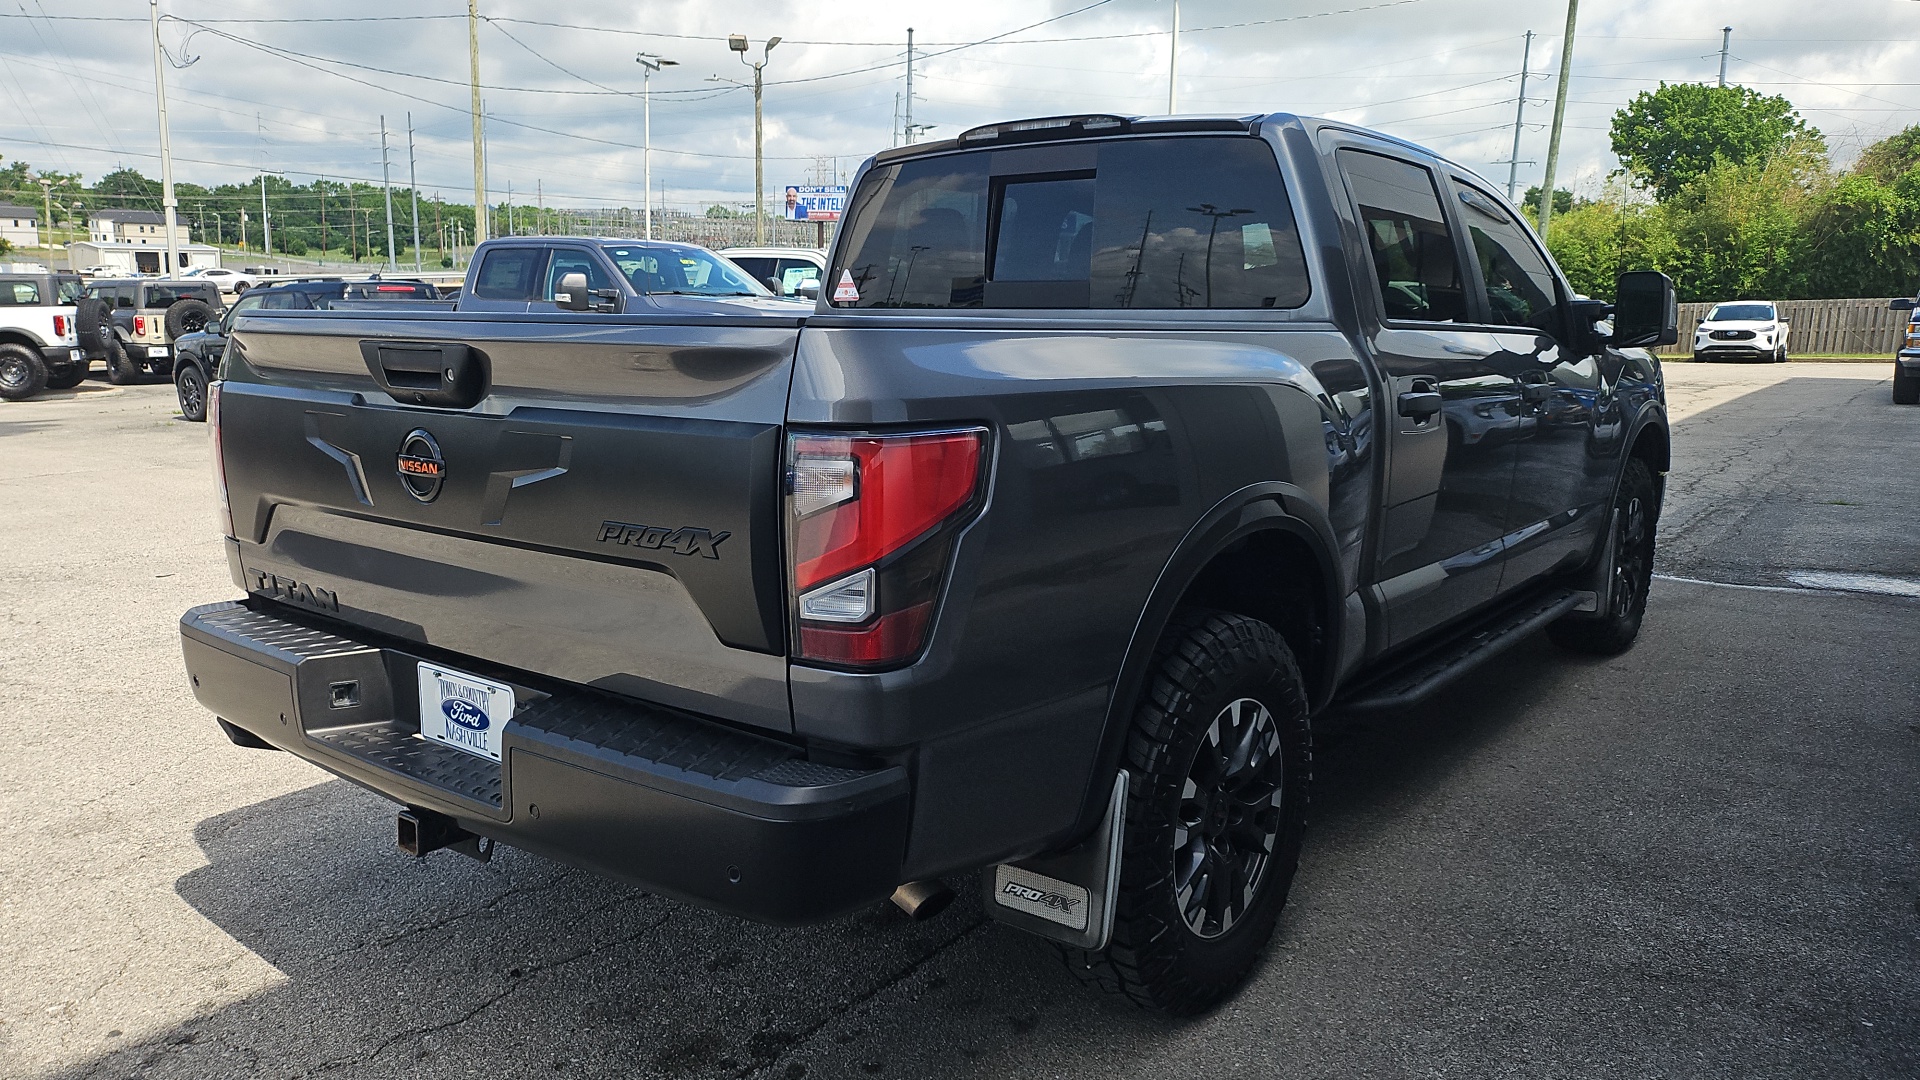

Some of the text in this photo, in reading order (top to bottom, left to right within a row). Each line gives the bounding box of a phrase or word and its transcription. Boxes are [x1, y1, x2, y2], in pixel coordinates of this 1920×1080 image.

[801, 197, 817, 210] THE
[400, 458, 438, 474] NISSAN
[248, 567, 340, 613] TITAN
[438, 678, 490, 715] TOWN & COUNTRY
[450, 700, 480, 728] Ford
[445, 718, 489, 751] NASHVILLE
